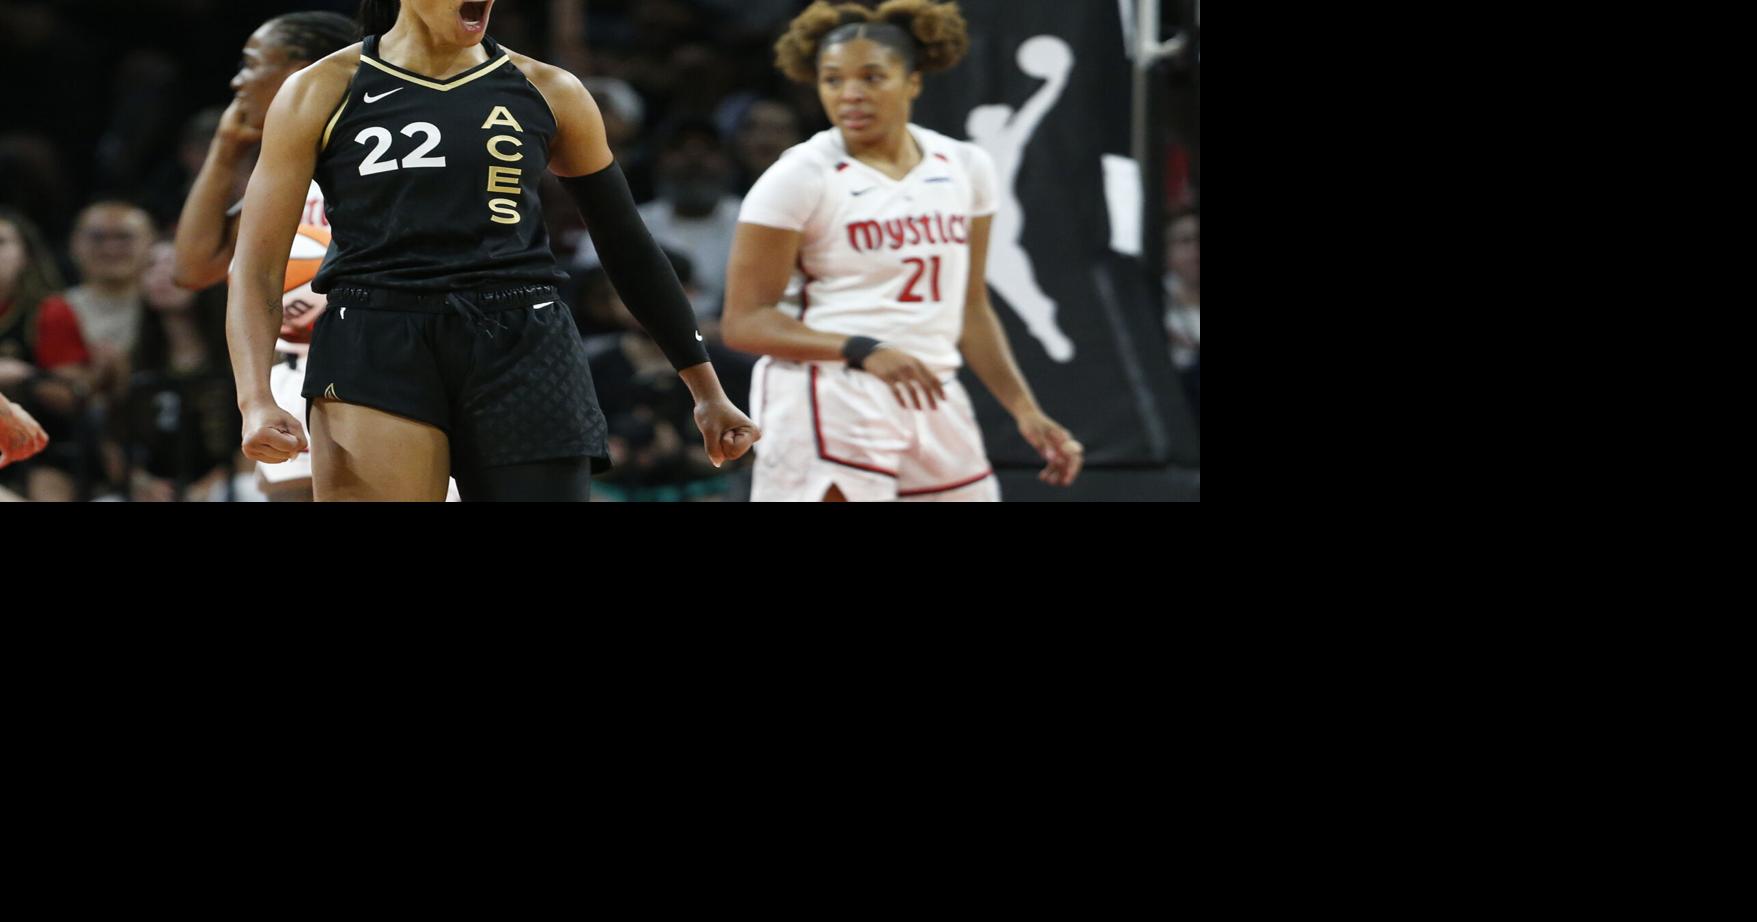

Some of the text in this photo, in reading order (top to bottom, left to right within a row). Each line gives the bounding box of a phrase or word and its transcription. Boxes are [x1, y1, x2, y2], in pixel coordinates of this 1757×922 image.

[354, 121, 446, 177] 22
[481, 105, 524, 225] ACES
[897, 254, 941, 302] 21
